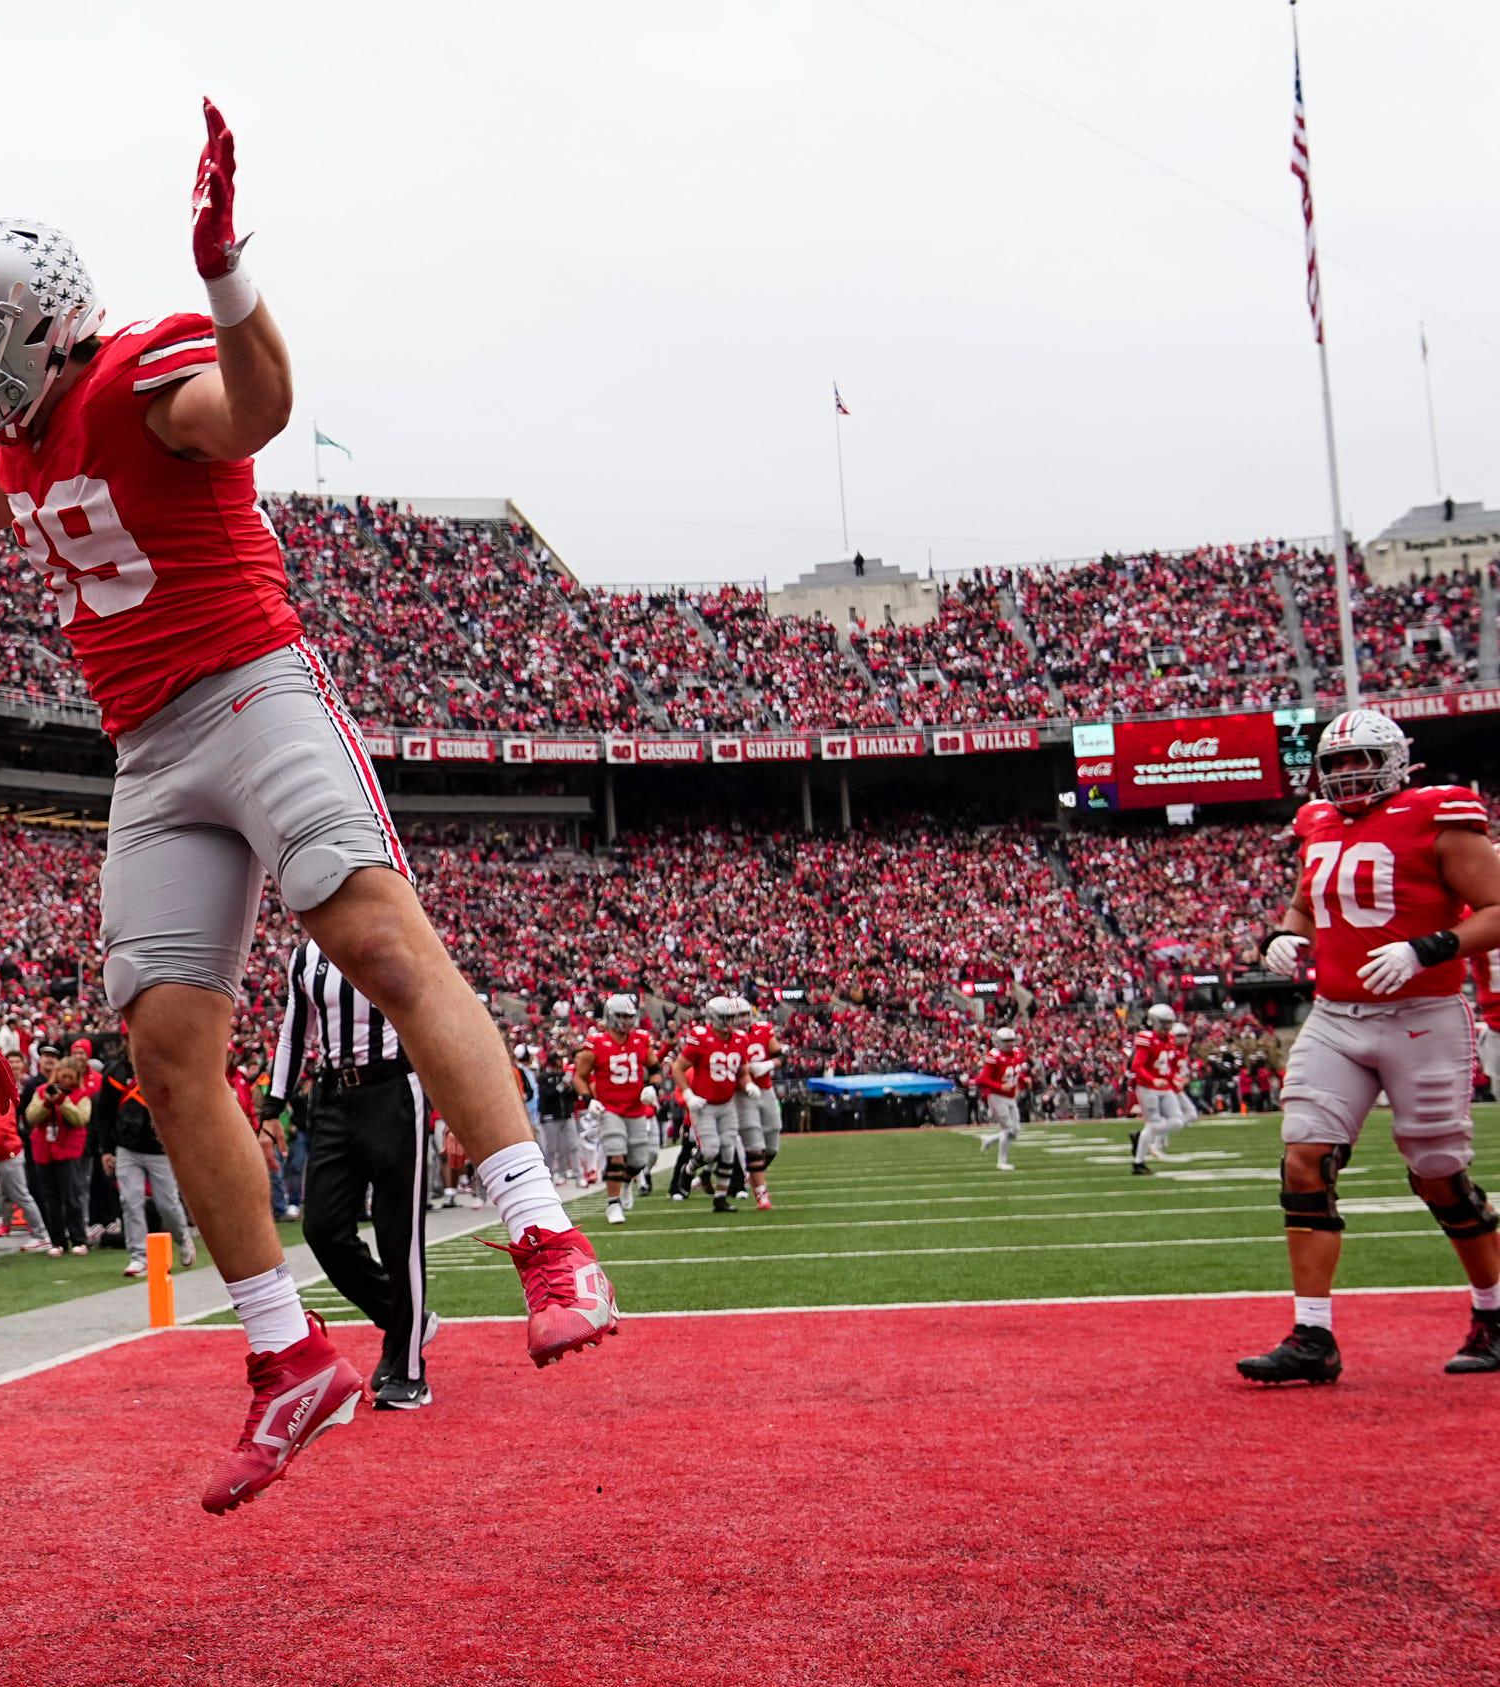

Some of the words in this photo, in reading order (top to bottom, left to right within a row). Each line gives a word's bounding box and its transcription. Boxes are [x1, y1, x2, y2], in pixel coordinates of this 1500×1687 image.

[1370, 696, 1449, 719] TIONAL
[1458, 690, 1500, 713] CHA
[436, 740, 490, 759] GEORGE
[746, 740, 807, 758] GRIFFIN
[856, 736, 917, 756] HARLEY
[972, 731, 1031, 750] WILLIS
[638, 742, 699, 760] CASSADY
[1133, 757, 1260, 774] TOUCHDOWN
[1132, 769, 1262, 785] CELEBRATION
[1304, 840, 1396, 929] 70
[609, 1052, 639, 1085] 51
[287, 1395, 315, 1439] ALPHA
